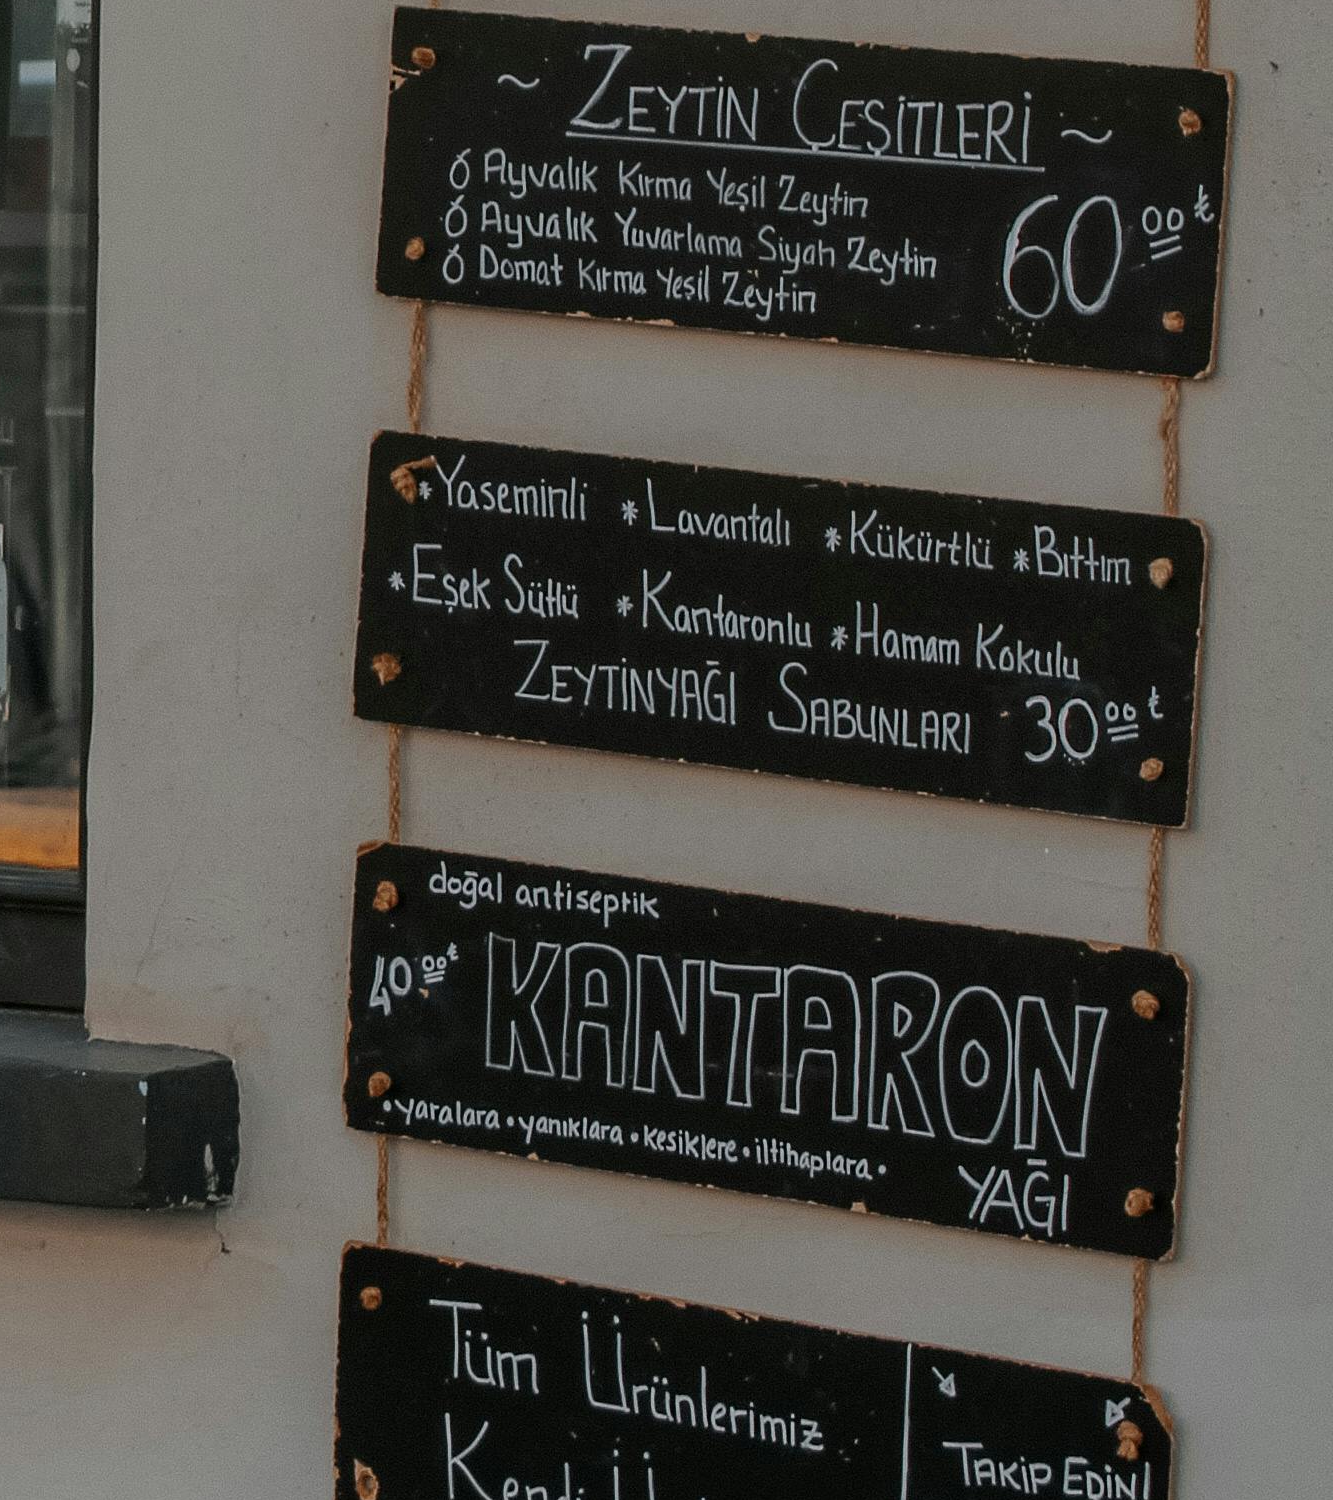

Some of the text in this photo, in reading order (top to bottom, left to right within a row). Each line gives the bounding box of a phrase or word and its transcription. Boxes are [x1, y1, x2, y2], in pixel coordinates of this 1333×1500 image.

[569, 44, 1032, 163] ZEYTİN ÇEŞİTLERİ
[483, 149, 870, 225] Ayvalık Kırma Yeşil Zeytin
[479, 243, 818, 319] Domat Kırma Yeşil Zeytin
[481, 200, 598, 251] Ayvalık
[615, 208, 743, 259] Yuvarlama
[847, 235, 938, 285] Zeytin
[432, 456, 589, 522] Yaseminli
[647, 478, 790, 548] Lavantalı
[849, 509, 994, 570] Kükürtlü
[412, 544, 1082, 682] Eşek Sütlü Kantaronlu Hamam Kokulu
[768, 663, 971, 756] SABUNLARI
[429, 860, 660, 933] doğal antiseptik
[484, 931, 1108, 1157] KANTARON
[395, 1096, 501, 1129] yaralara
[959, 1158, 1070, 1237] YAĞI
[429, 1299, 826, 1453] Tüm Ürünlerimiz
[942, 1440, 1053, 1495] TAKİP
